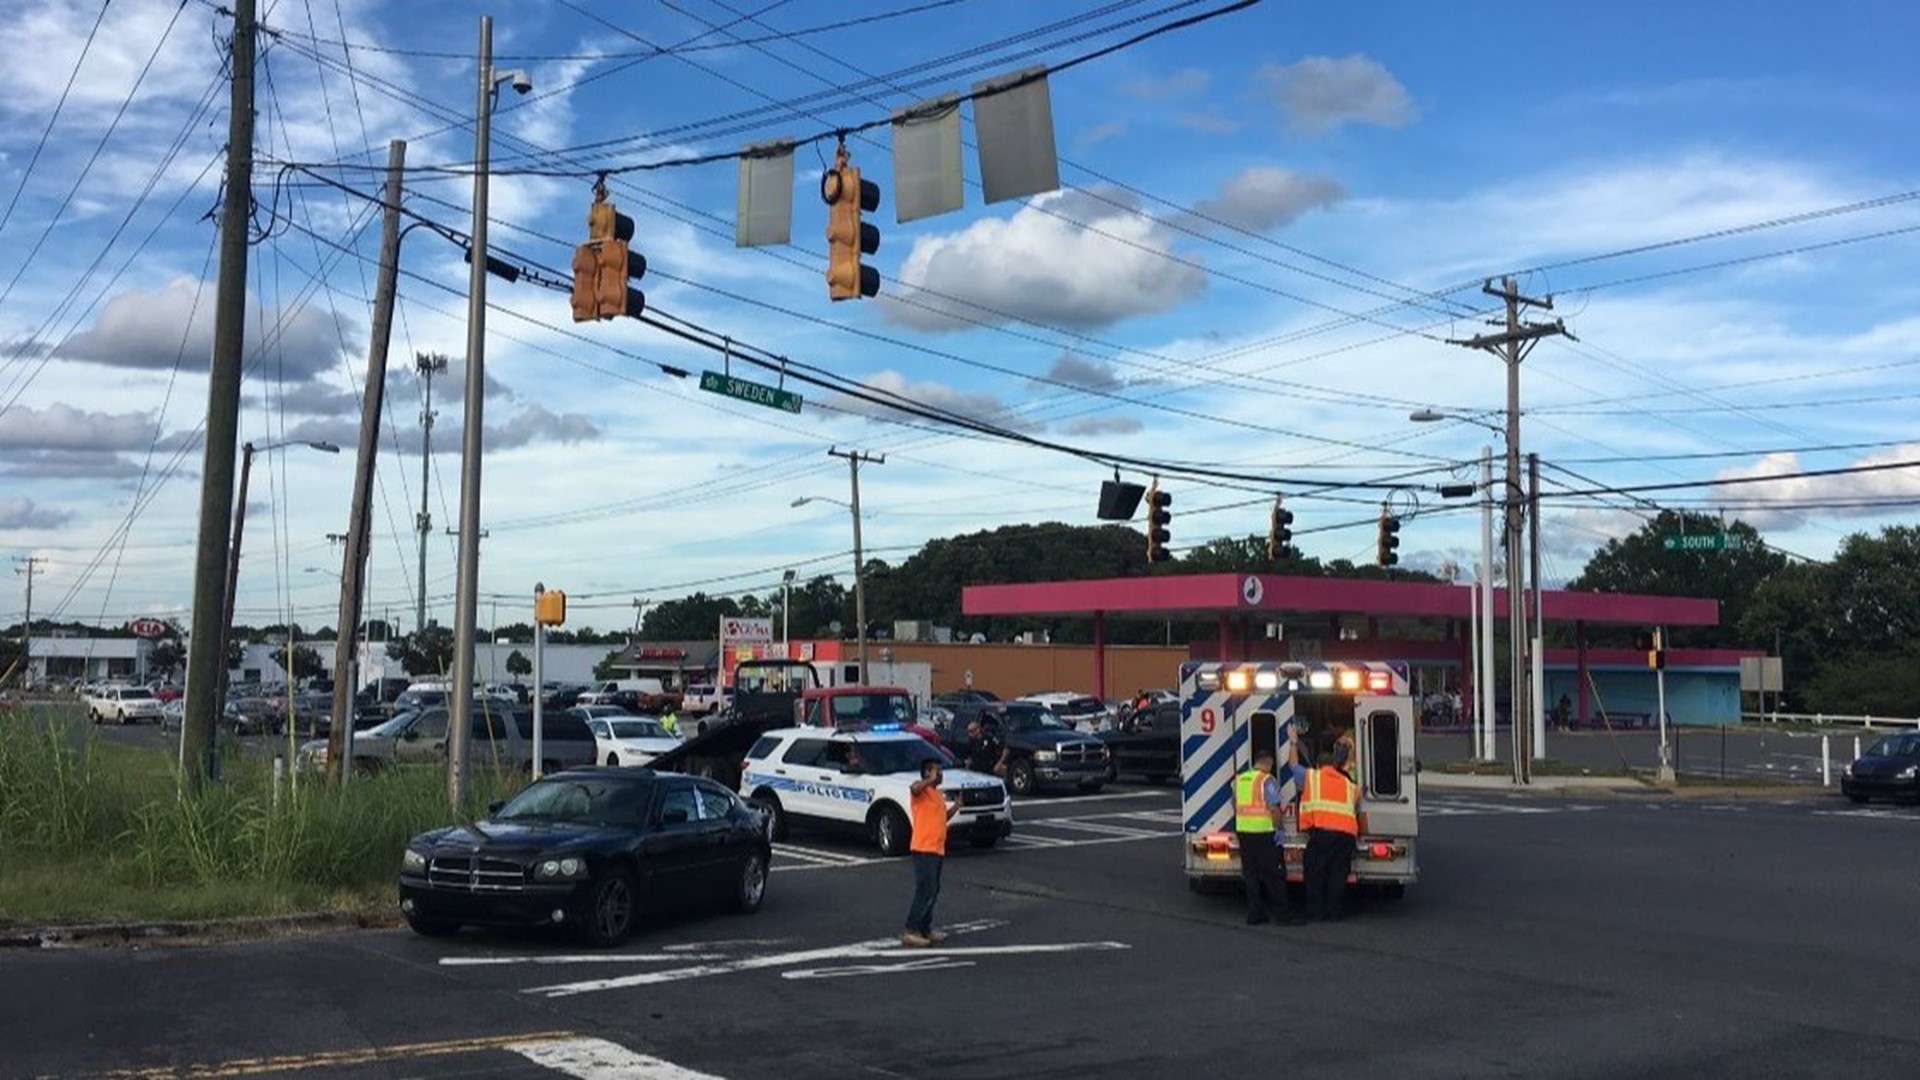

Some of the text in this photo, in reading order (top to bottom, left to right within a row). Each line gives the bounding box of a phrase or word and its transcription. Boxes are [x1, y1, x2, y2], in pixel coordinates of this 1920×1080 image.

[726, 379, 776, 404] SWEDEN
[1682, 535, 1716, 549] SOUTH
[136, 623, 161, 633] KIA
[1200, 708, 1216, 733] 9
[796, 784, 852, 799] POLICE
